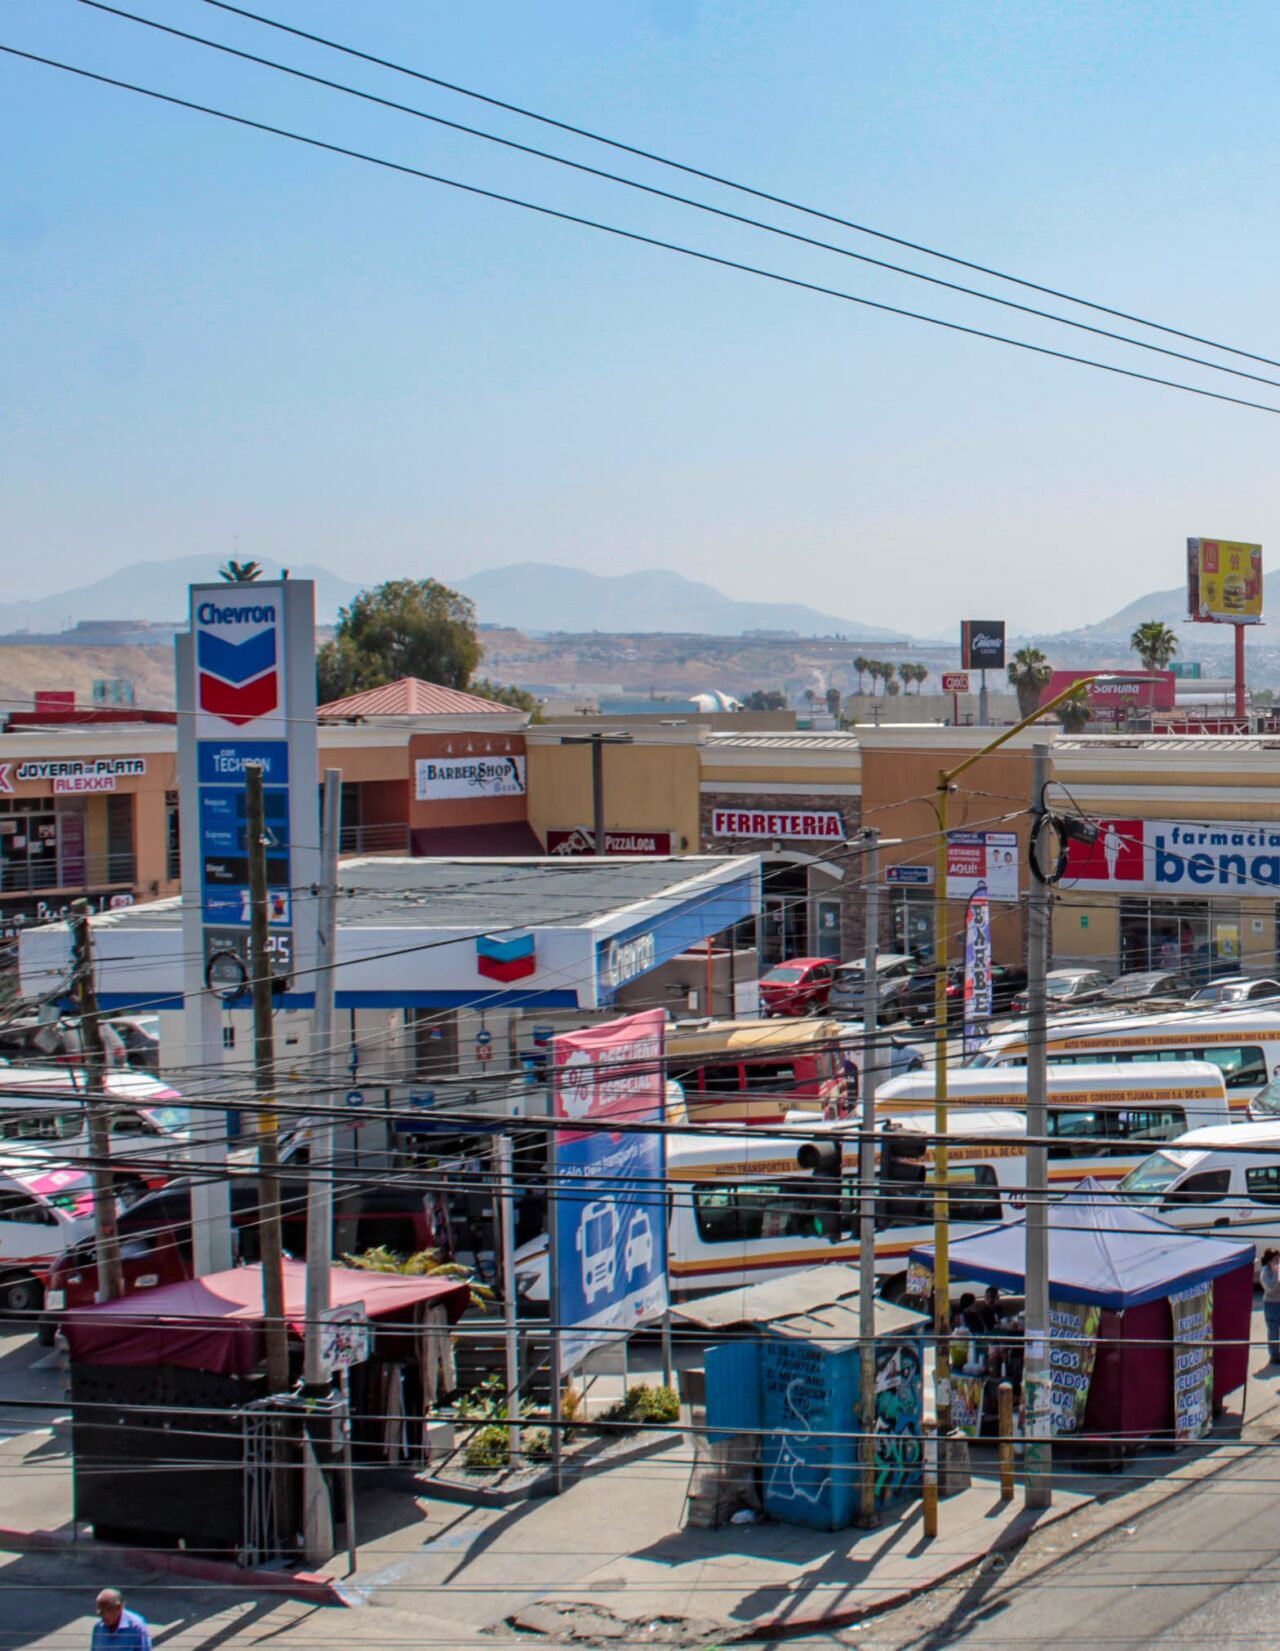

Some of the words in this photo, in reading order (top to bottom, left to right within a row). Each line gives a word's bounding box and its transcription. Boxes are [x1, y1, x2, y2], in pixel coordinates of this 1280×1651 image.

[198, 603, 276, 625] Chevron
[18, 762, 83, 778] JOYERIA
[97, 760, 144, 773] PLATA
[56, 779, 112, 790] ALEXXA
[716, 813, 840, 835] FERRETERIA
[608, 932, 655, 987] Chevron
[1080, 1038, 1118, 1048] TRANSPORTES
[1190, 1034, 1219, 1043] CORREDOR
[1220, 1032, 1242, 1042] TIJUANA
[1048, 1093, 1087, 1104] UBURBANOS
[1091, 1091, 1125, 1102] CORREDOR
[1127, 1090, 1154, 1100] TIJUANA
[966, 1149, 982, 1159] 2000
[737, 1162, 791, 1175] TRANSPORTES
[1050, 1349, 1079, 1368] GOS
